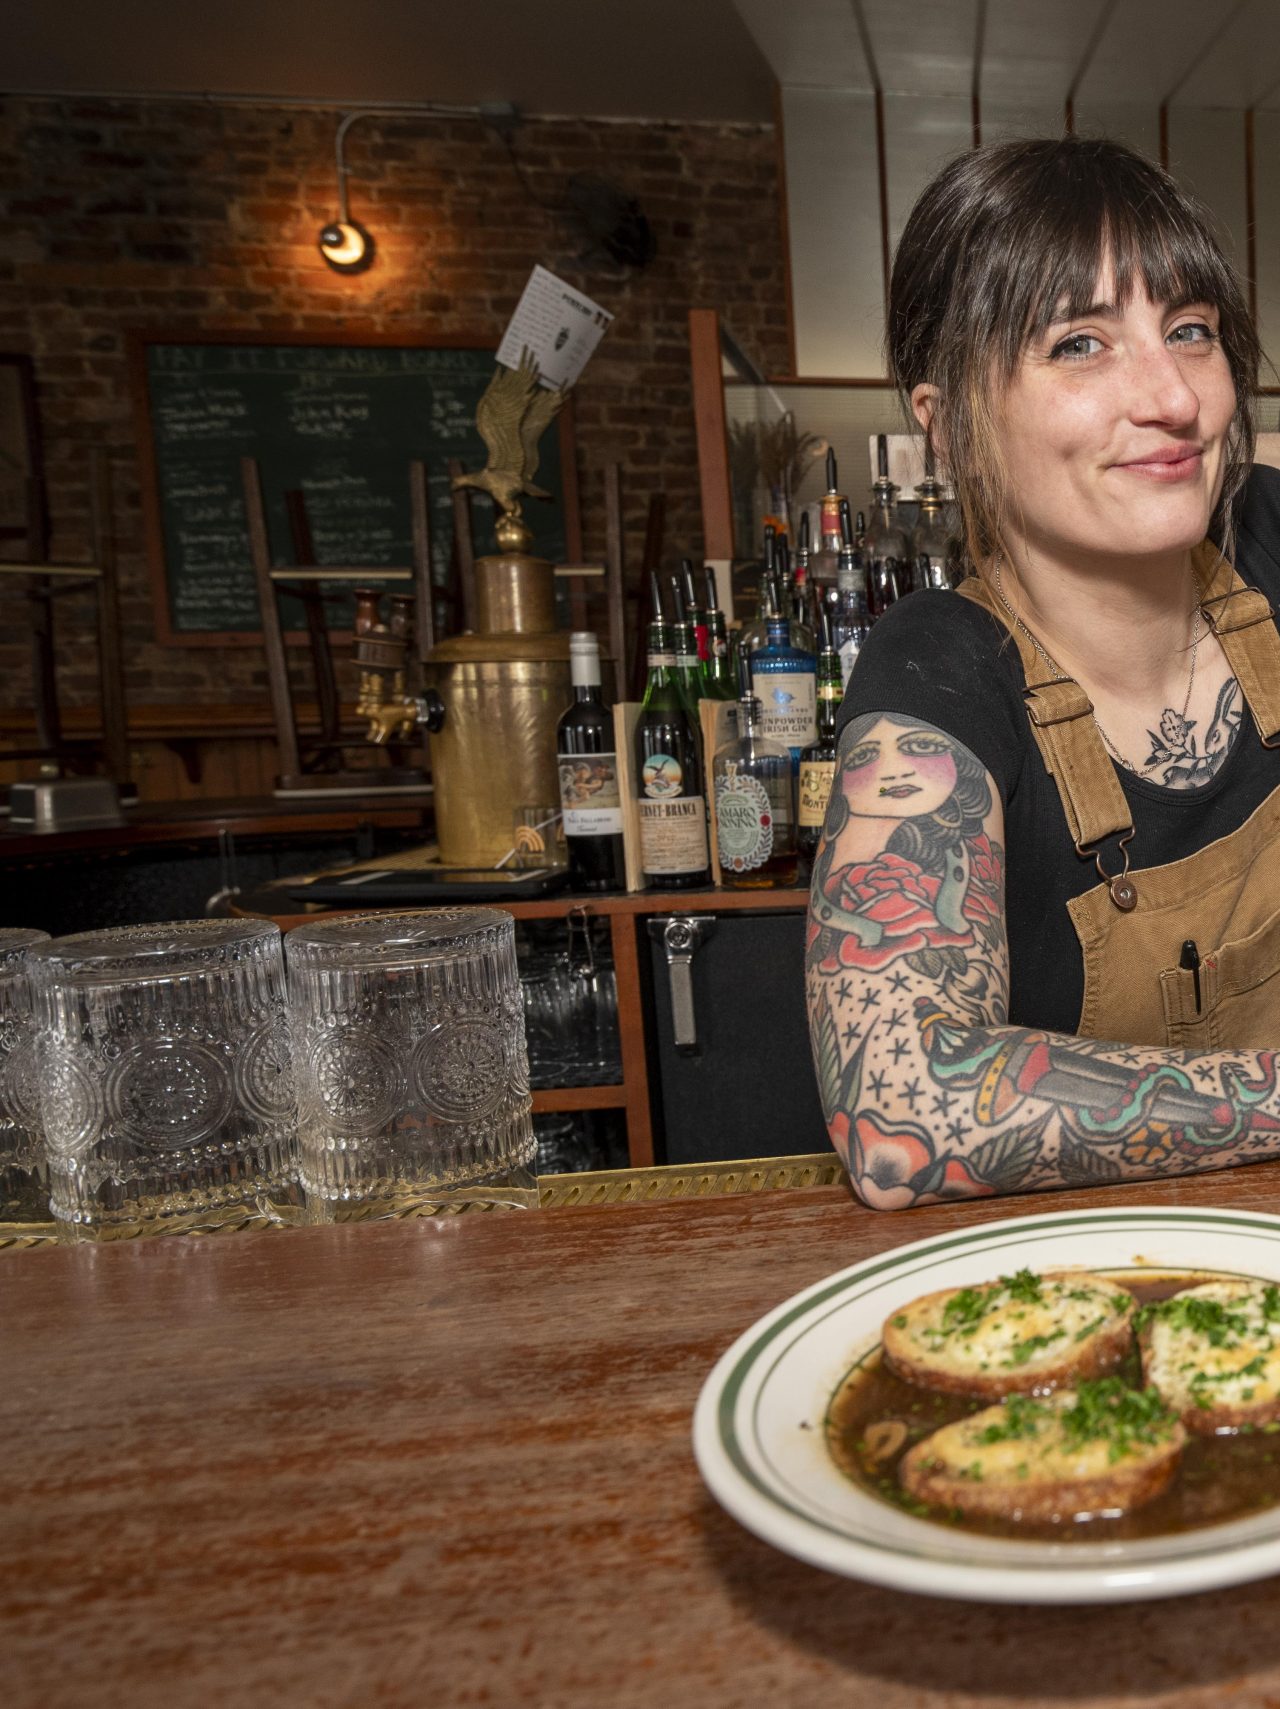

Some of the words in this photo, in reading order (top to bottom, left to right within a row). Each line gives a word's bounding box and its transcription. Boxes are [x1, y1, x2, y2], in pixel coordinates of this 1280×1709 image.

[763, 725, 789, 734] IRISH
[640, 803, 697, 817] ERNET-BRANCA
[720, 806, 755, 818] AMARO
[720, 817, 757, 828] NONINO
